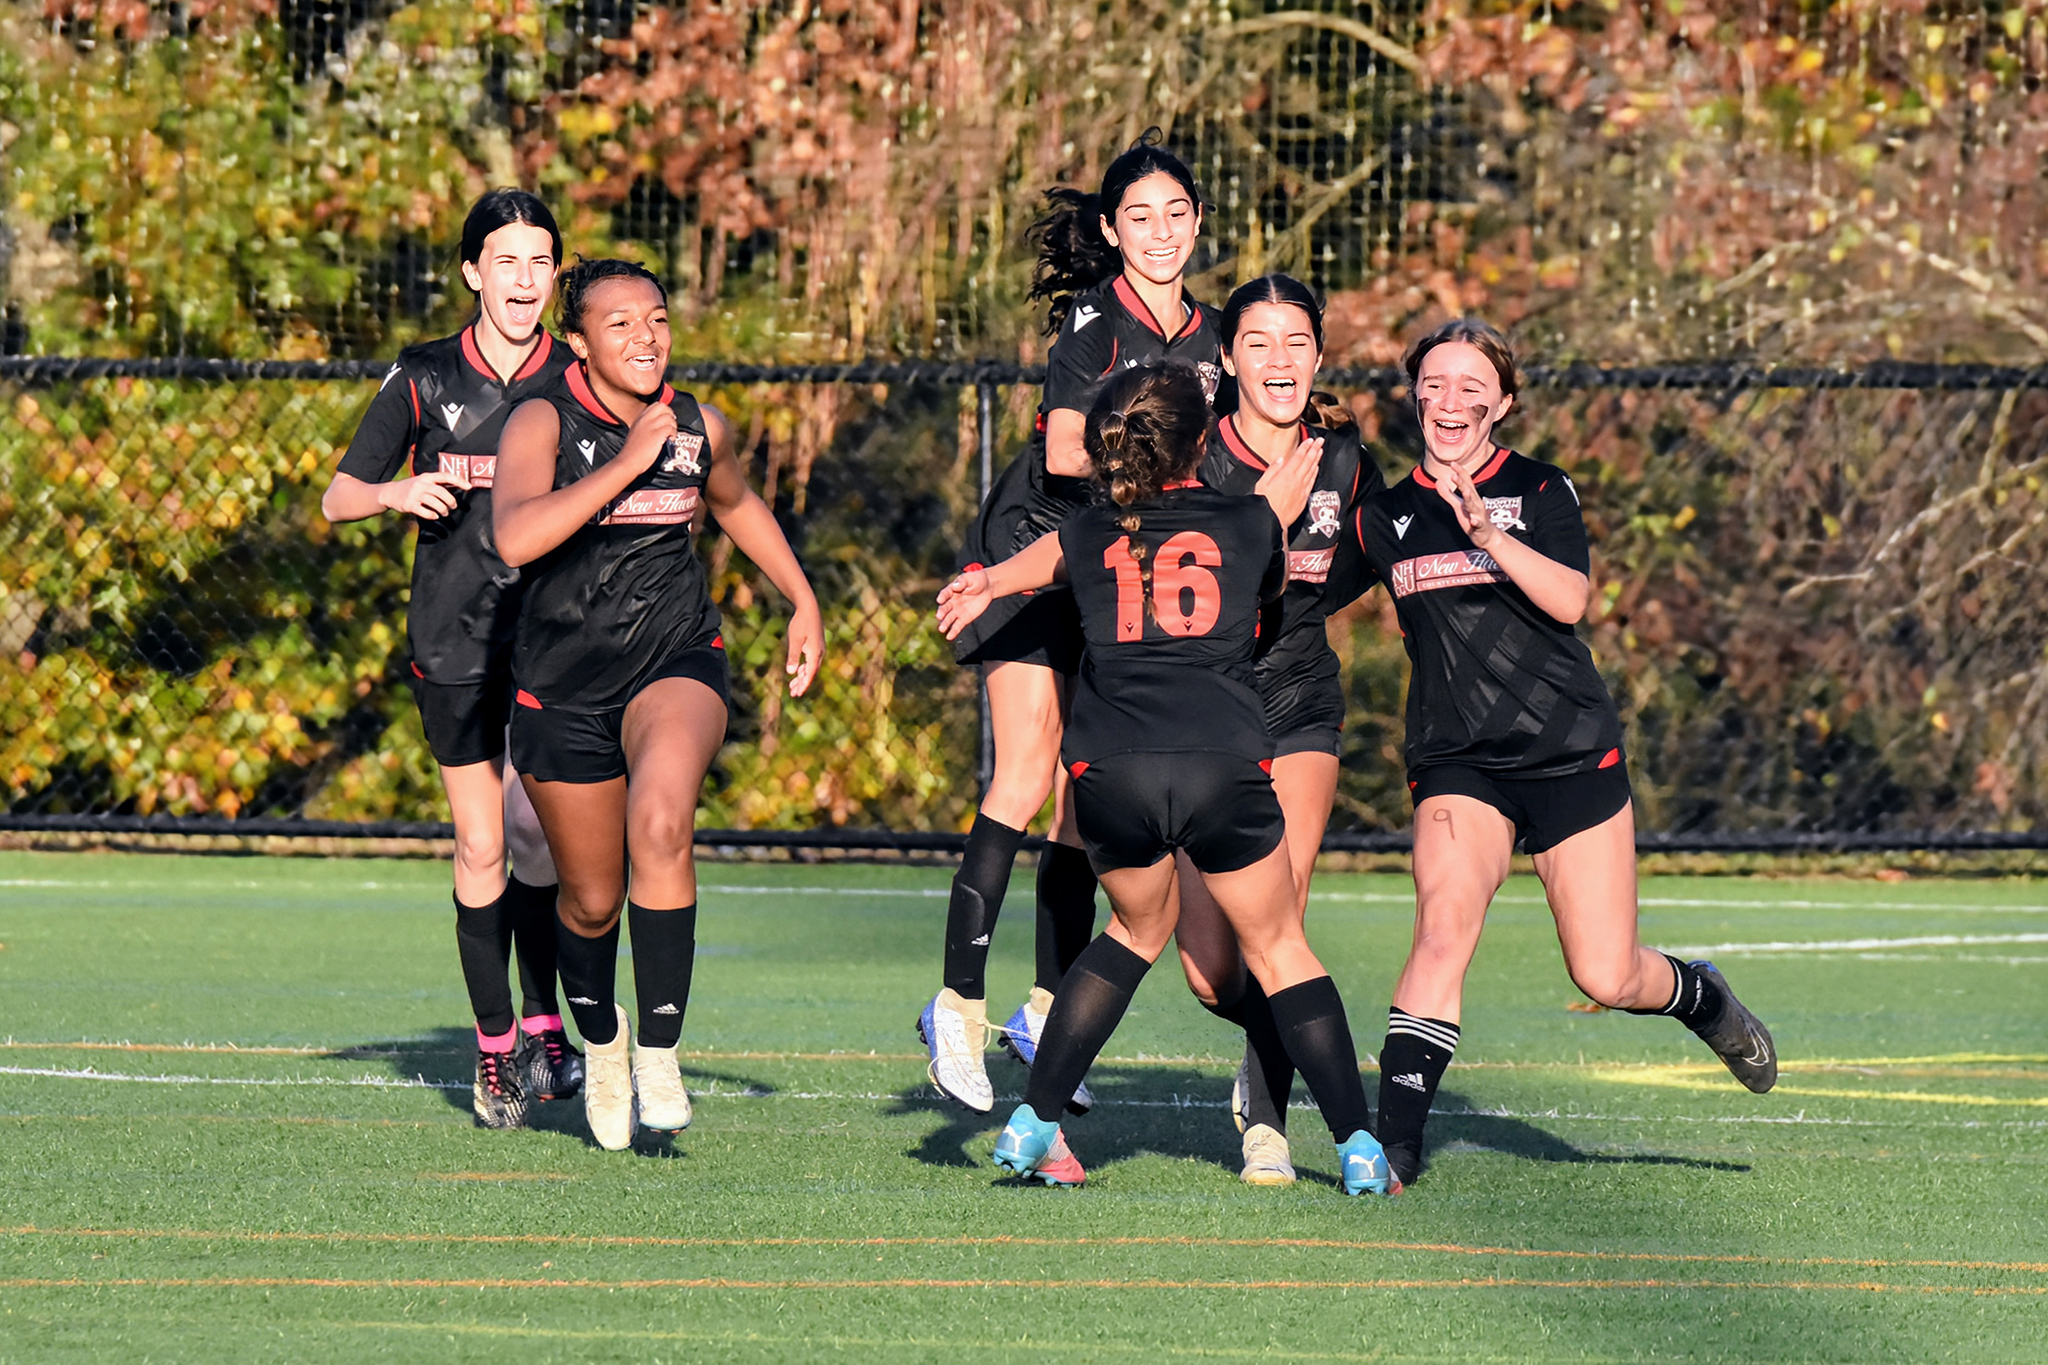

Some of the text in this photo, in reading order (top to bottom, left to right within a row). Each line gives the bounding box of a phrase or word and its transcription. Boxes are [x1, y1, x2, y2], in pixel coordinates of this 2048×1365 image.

[614, 492, 653, 514] New
[1418, 555, 1458, 578] New
[1104, 531, 1222, 643] 16
[1432, 808, 1455, 841] 9
[1391, 1075, 1426, 1093] adidas
